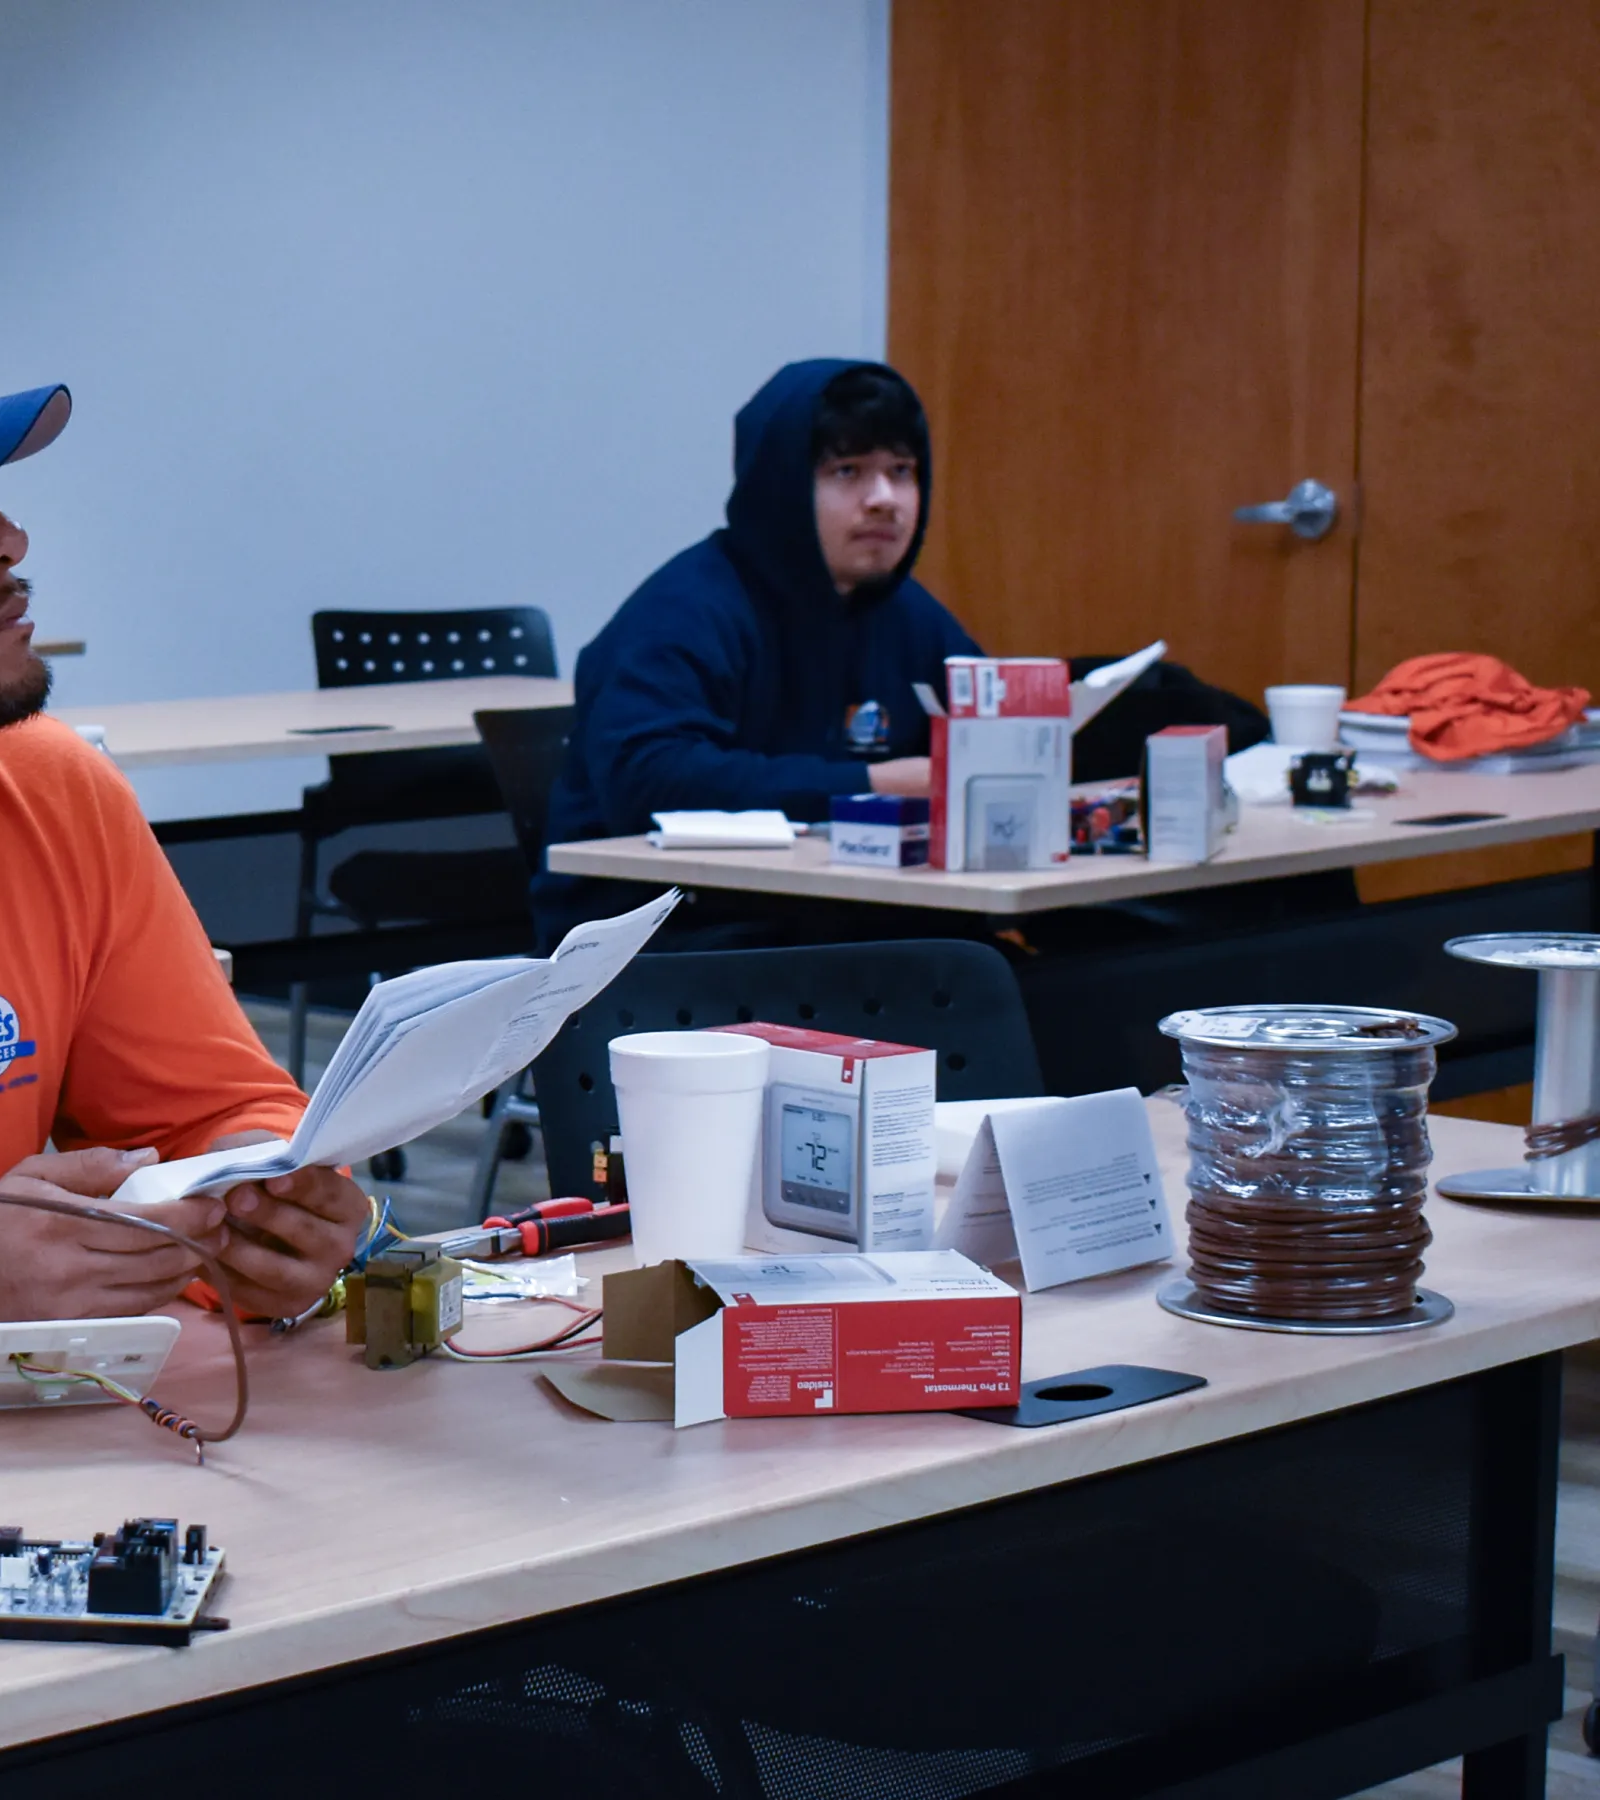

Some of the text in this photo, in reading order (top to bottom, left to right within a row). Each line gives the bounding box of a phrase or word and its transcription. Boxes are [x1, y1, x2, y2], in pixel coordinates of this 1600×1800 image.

[803, 1141, 828, 1172] 72
[796, 1380, 834, 1391] resideo
[924, 1382, 1011, 1394] T3 Pro Thermostat
